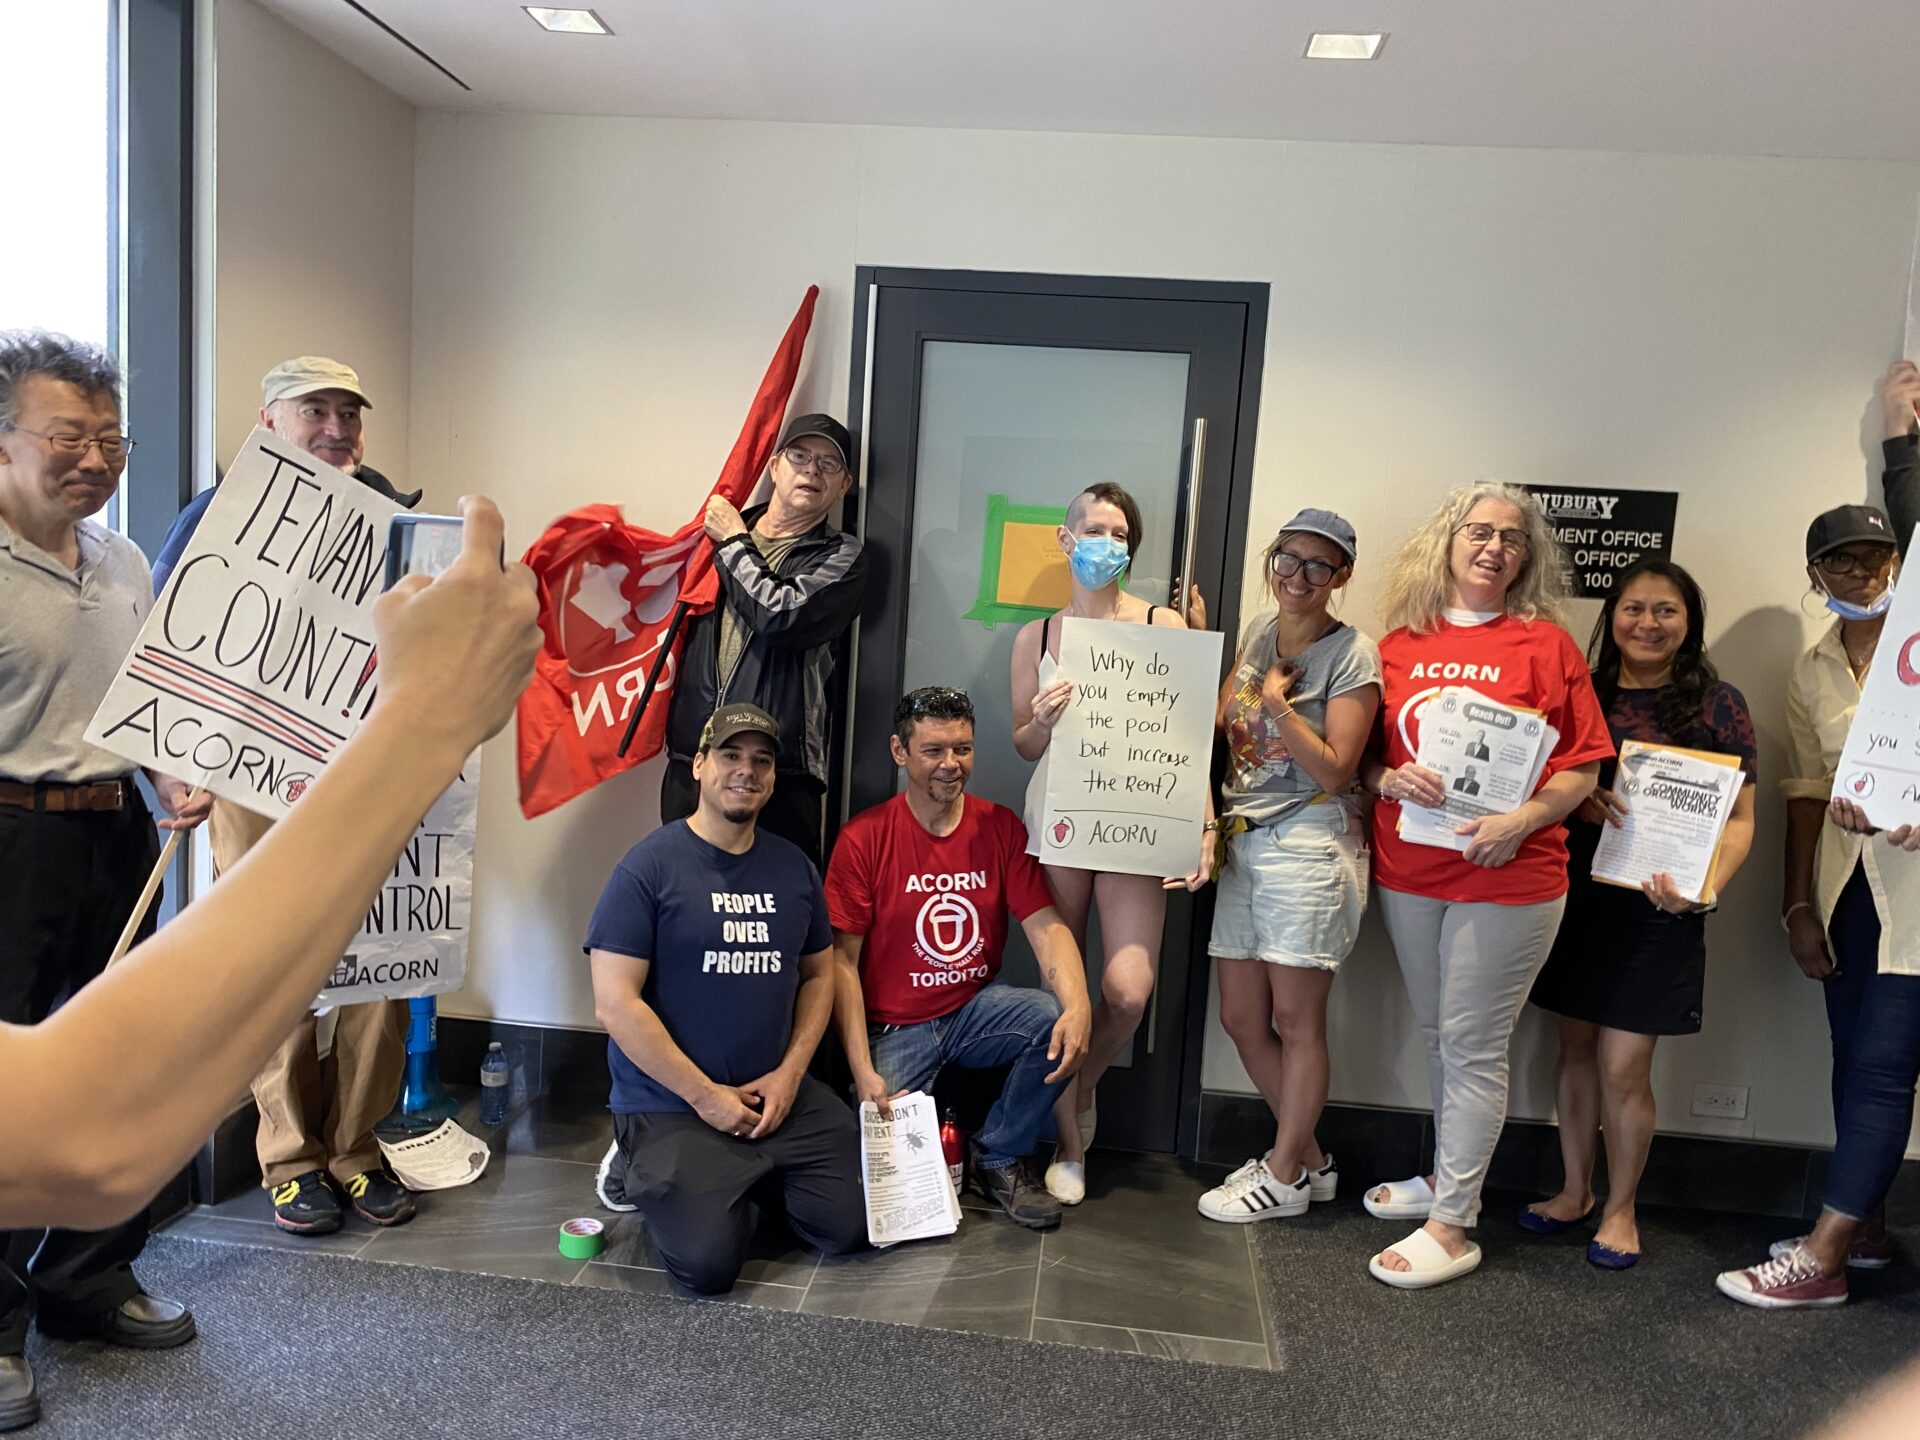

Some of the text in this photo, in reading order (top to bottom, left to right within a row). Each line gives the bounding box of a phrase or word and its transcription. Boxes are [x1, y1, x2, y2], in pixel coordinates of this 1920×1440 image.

[1601, 530, 1662, 549] OFFICE
[1584, 572, 1613, 588] 100
[1090, 646, 1169, 680] Why do
[1409, 662, 1501, 683] ACORN
[1076, 684, 1180, 710] you empty
[1086, 711, 1168, 738] the pool
[102, 697, 286, 797] ACORN
[1078, 738, 1192, 768] but increase
[1867, 733, 1898, 754] you
[1083, 769, 1117, 793] the
[1088, 820, 1157, 846] ACORN
[905, 870, 987, 893] ACORN
[711, 893, 777, 914] PEOPLE
[722, 920, 770, 943] OVER
[702, 950, 782, 974] PROFITS
[911, 941, 925, 957] THE
[924, 955, 953, 970] PEOPLE
[972, 937, 985, 957] RULE
[355, 957, 439, 986] ACORN
